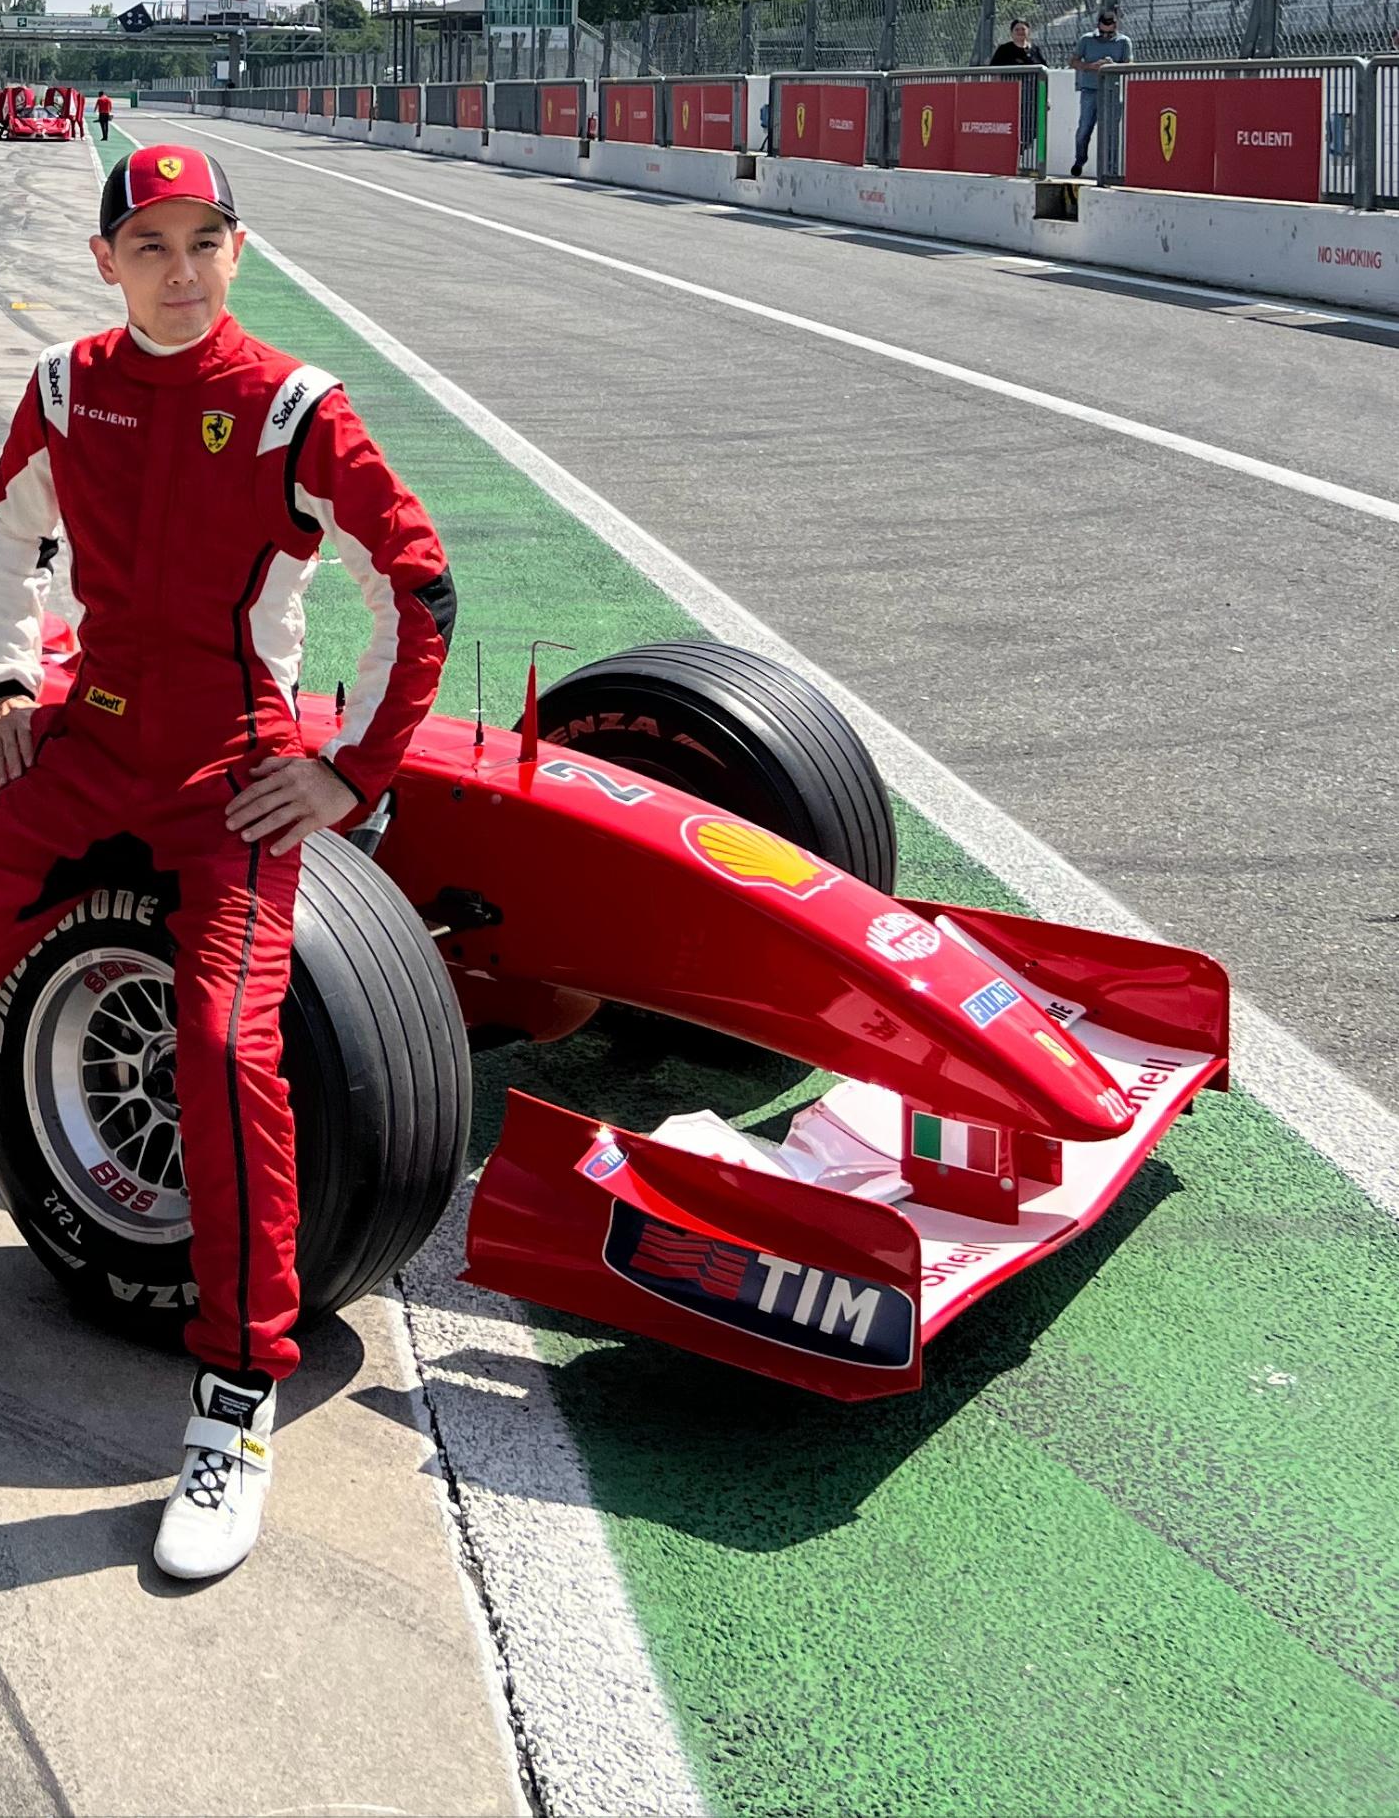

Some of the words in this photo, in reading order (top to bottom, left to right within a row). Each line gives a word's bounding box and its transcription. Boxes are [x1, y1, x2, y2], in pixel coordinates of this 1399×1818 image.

[1237, 131, 1250, 145] F1
[1251, 131, 1292, 147] CLIENTI
[1318, 246, 1332, 263] NO
[1334, 247, 1382, 269] SMOKING
[48, 358, 63, 406] Sabelt
[73, 404, 85, 416] F1
[88, 409, 138, 428] CLIENTI
[272, 382, 309, 430] Sabelt
[538, 760, 656, 806] 2
[966, 981, 1018, 1023] FIAT
[89, 1160, 158, 1213] BBS
[757, 1253, 882, 1346] TIM
